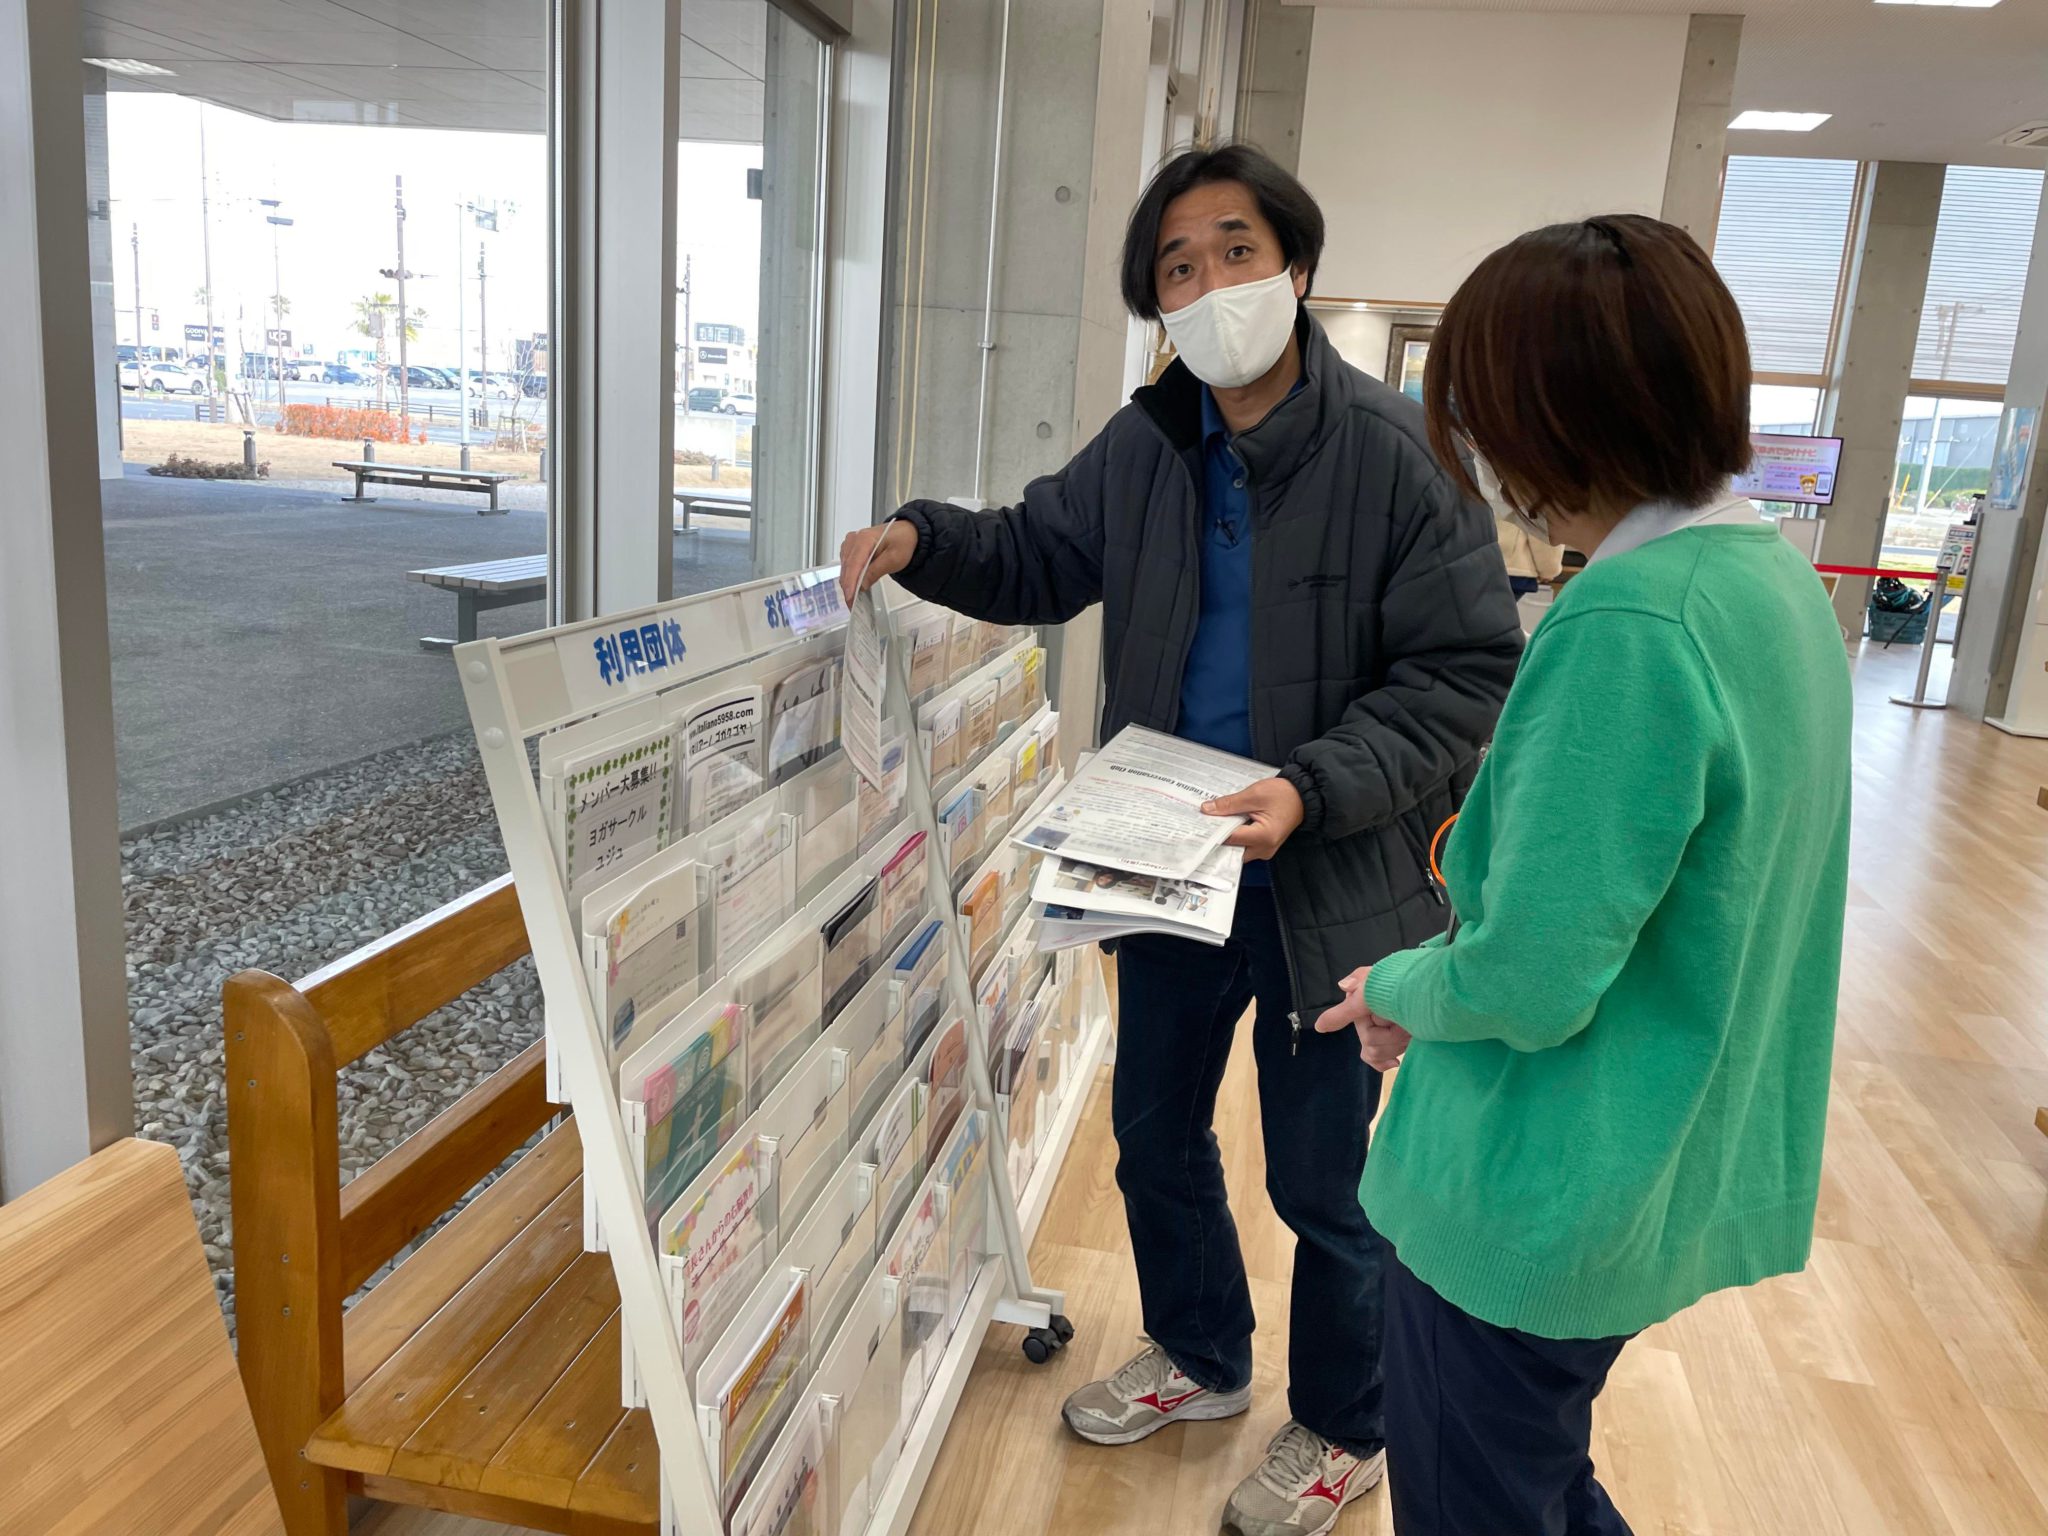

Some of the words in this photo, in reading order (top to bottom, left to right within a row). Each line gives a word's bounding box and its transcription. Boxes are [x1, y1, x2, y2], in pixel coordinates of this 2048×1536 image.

[593, 617, 687, 687] 利用団体
[580, 762, 657, 813] メンバー大募集!!
[1110, 765, 1127, 773] Club
[1127, 769, 1175, 784] Conversation
[589, 804, 647, 847] ヨガサークル
